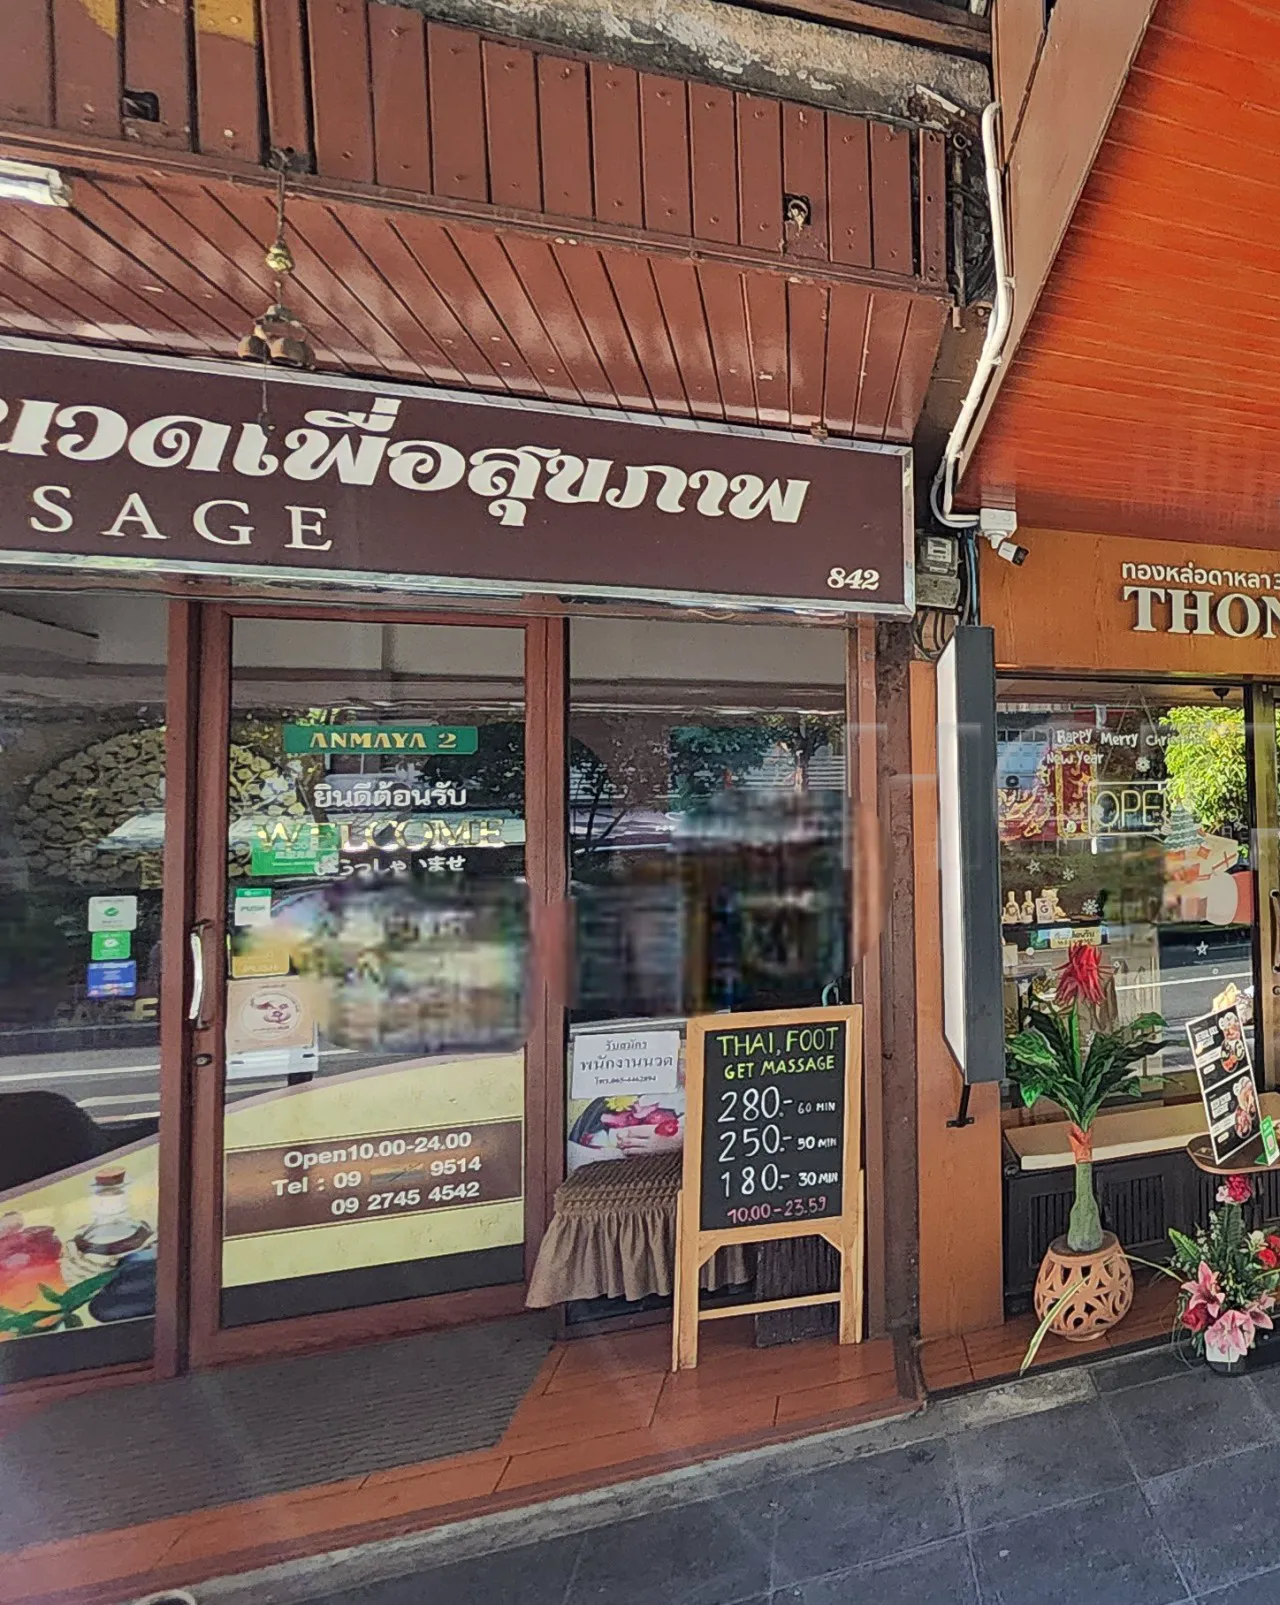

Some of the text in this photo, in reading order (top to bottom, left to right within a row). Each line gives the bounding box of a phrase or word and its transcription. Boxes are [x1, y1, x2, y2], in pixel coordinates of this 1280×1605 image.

[28, 485, 333, 552] SAGE
[826, 566, 880, 592] 842
[309, 732, 458, 749] ANMAYA 2
[1100, 732, 1139, 748] Merry
[1047, 749, 1104, 766] New Year
[312, 781, 467, 808] ยินดีต้อนรับ
[253, 819, 505, 852] WELCOME
[786, 1027, 839, 1052] FOOT
[580, 1054, 673, 1072] พนักงานนวด
[724, 1055, 835, 1080] GET MASSAGE
[815, 1101, 836, 1113] MIN
[817, 1136, 837, 1148] MIN
[271, 1177, 308, 1197] Tel
[333, 1171, 362, 1190] 09
[430, 1156, 482, 1178] 9514
[798, 1171, 817, 1186] 30
[818, 1171, 839, 1184] MIN
[331, 1181, 480, 1216] 09 2745 4542
